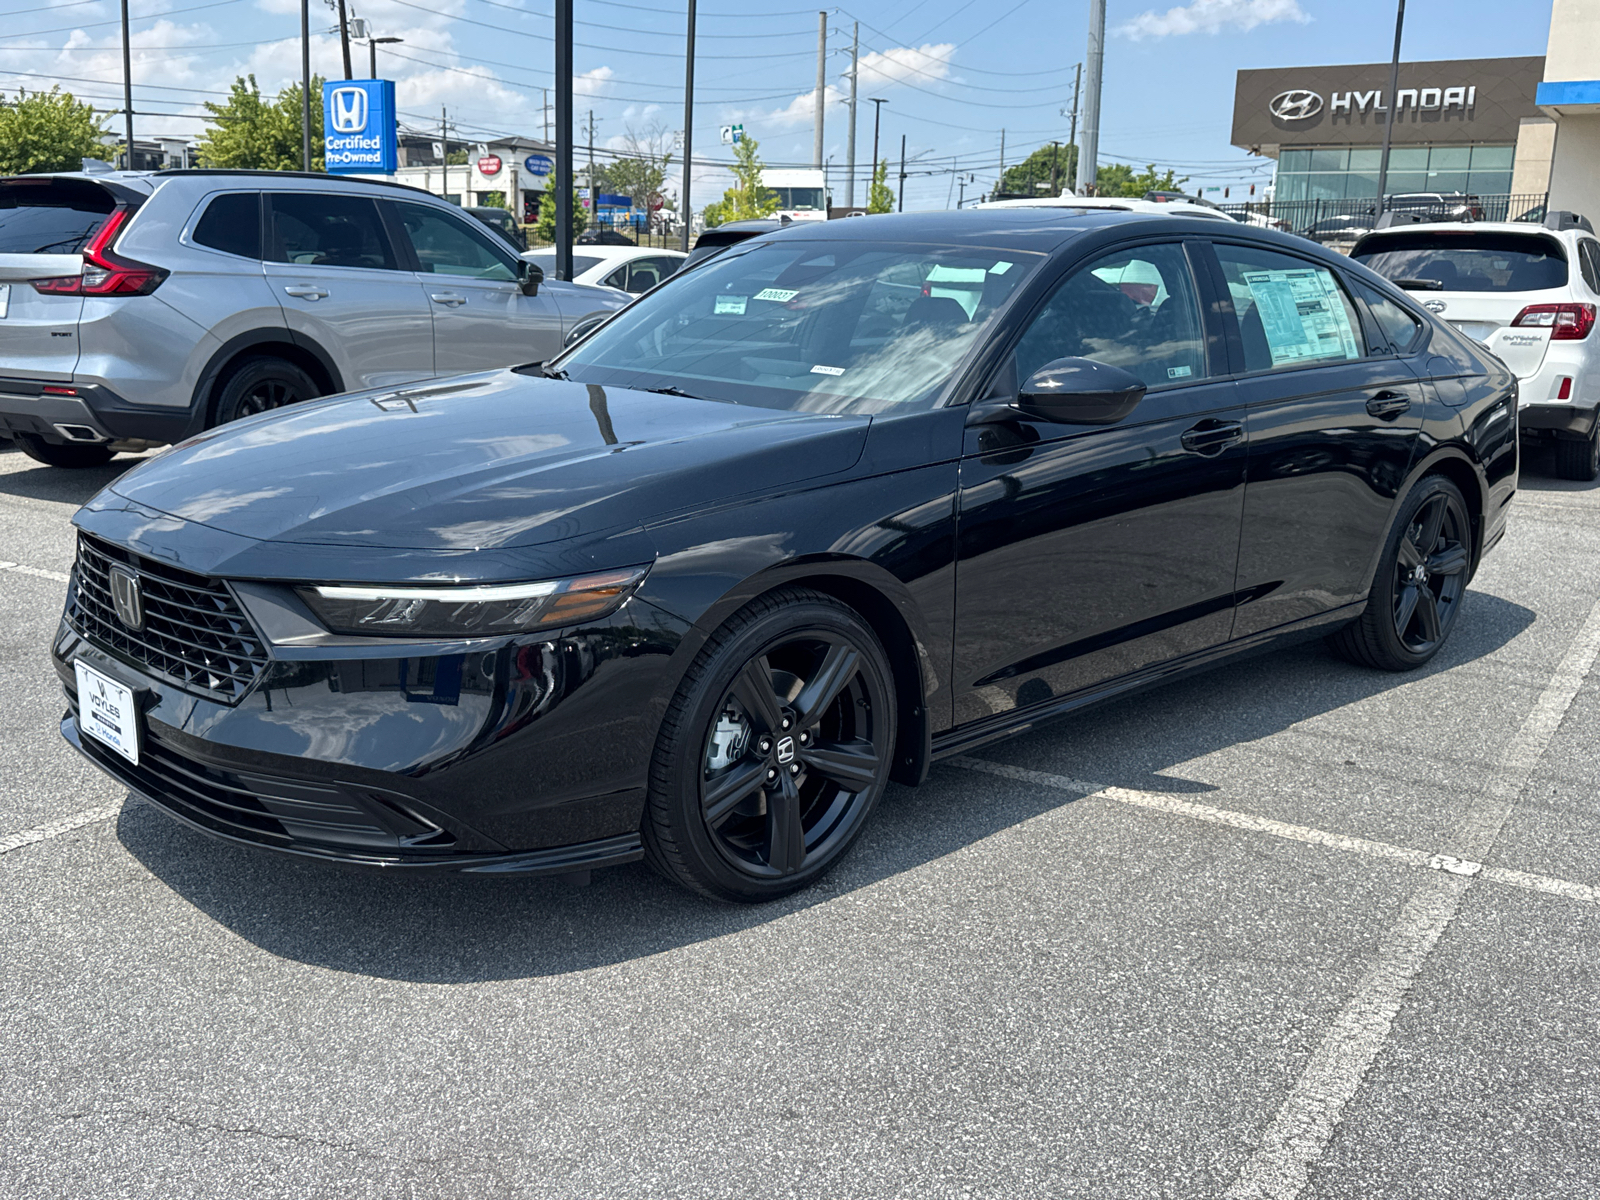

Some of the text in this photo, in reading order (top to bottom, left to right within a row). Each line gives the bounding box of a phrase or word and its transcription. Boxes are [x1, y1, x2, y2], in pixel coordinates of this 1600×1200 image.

[326, 135, 380, 150] Certified
[326, 151, 381, 163] Pre-Owned
[89, 691, 121, 719] VOYLES
